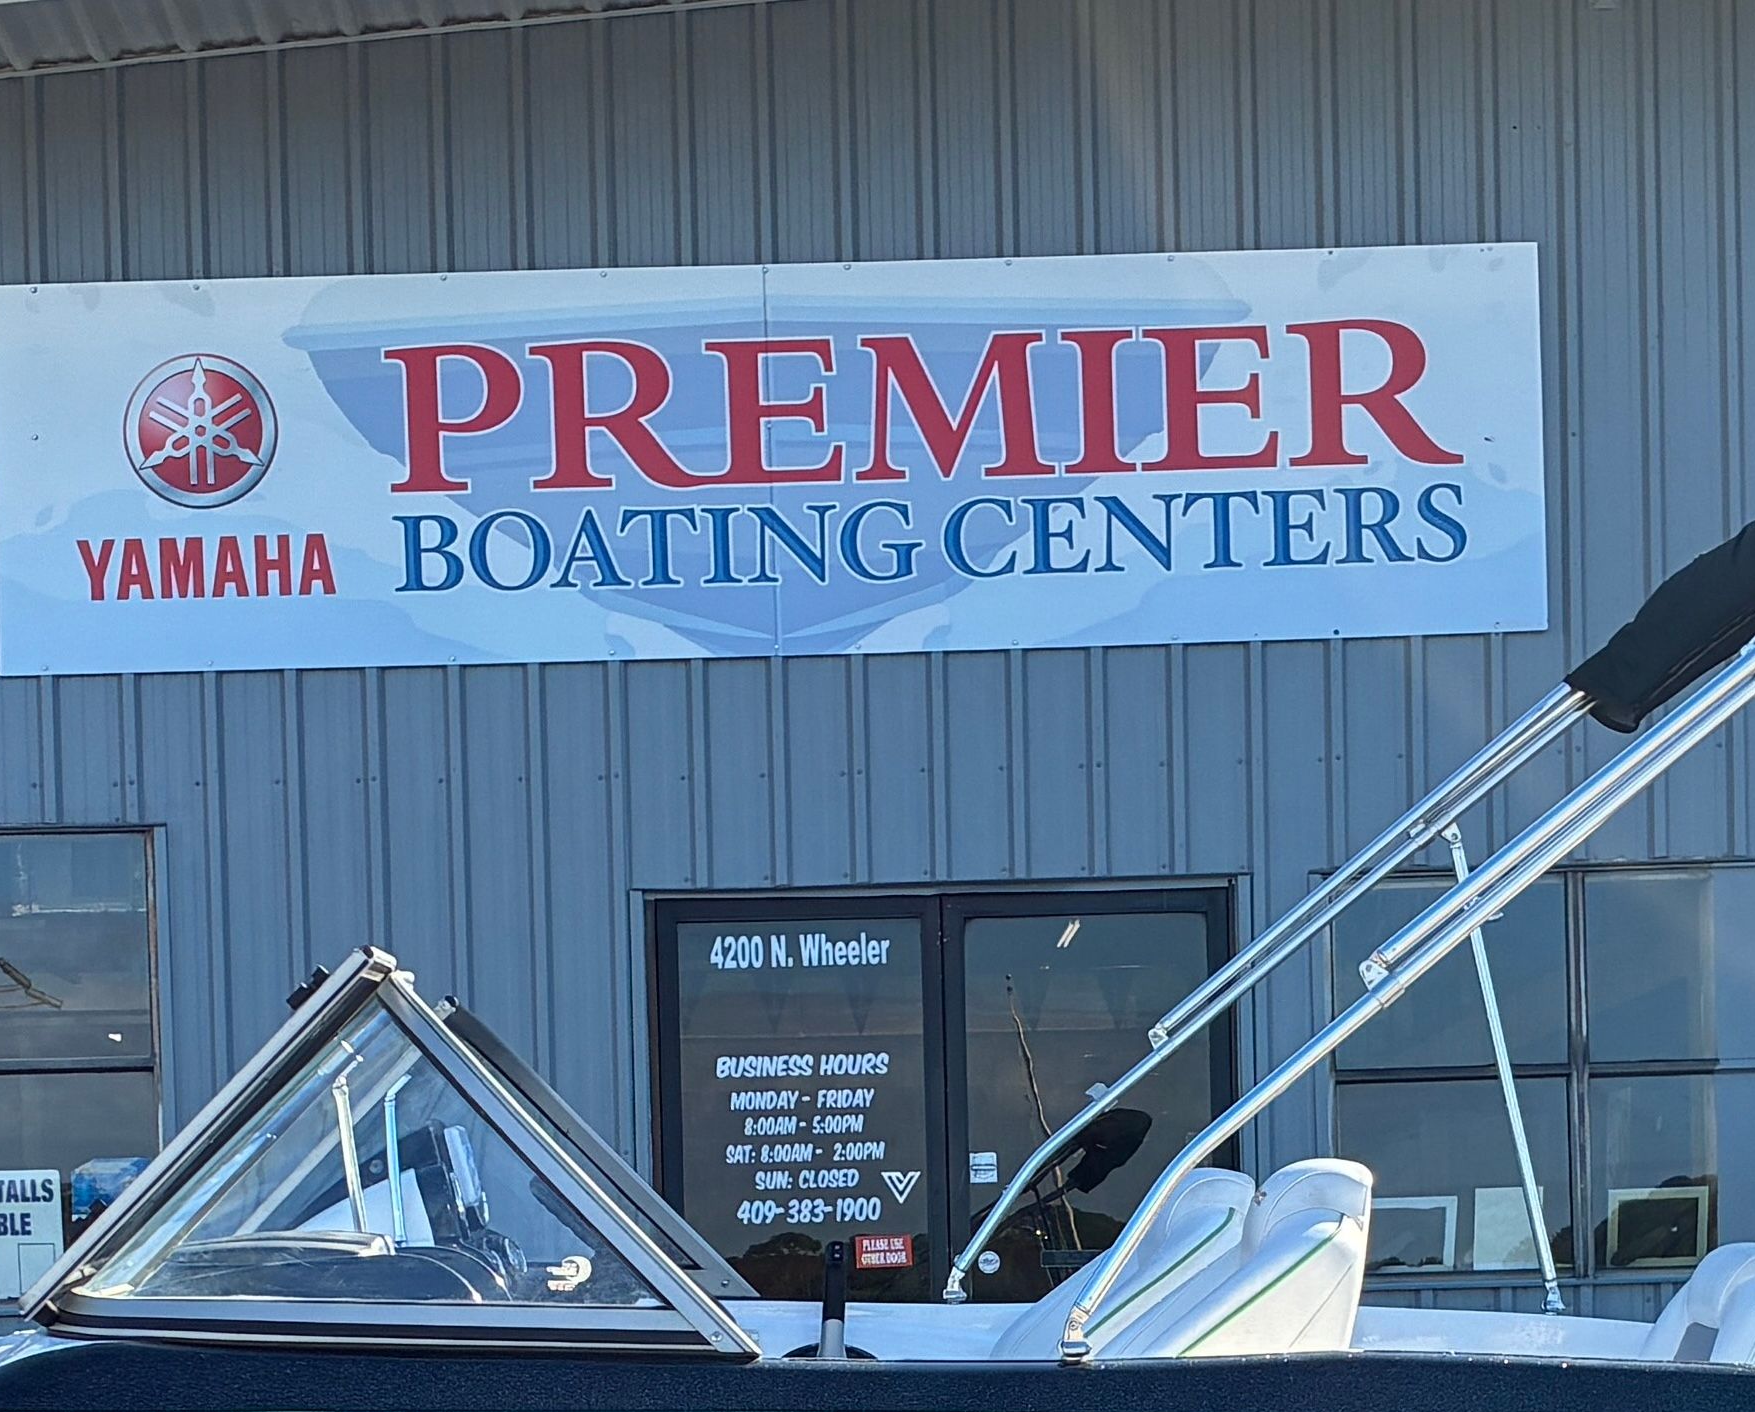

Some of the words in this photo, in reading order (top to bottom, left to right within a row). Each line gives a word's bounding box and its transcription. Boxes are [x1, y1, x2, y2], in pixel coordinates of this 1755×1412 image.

[382, 318, 1466, 496] PREMIER
[393, 499, 923, 594] BOATING
[943, 482, 1469, 579] CENTERS
[75, 531, 338, 603] YAMAHA
[710, 935, 764, 970] 4200
[770, 934, 794, 968] N.
[798, 931, 890, 967] Wheeler
[716, 1054, 814, 1079] BUSINESS
[819, 1052, 890, 1076] HOURS
[730, 1090, 799, 1111] MONDAY
[816, 1088, 875, 1109] FRIDAY
[744, 1115, 797, 1135] 8:00AM
[812, 1114, 864, 1134] 5:00PM
[726, 1145, 756, 1164] SAT:
[760, 1143, 814, 1163] 8:00AM
[832, 1141, 885, 1161] 2:00PM
[755, 1171, 793, 1190] SUN:
[798, 1168, 859, 1188] CLOSED
[737, 1197, 882, 1224] 409-383-1900
